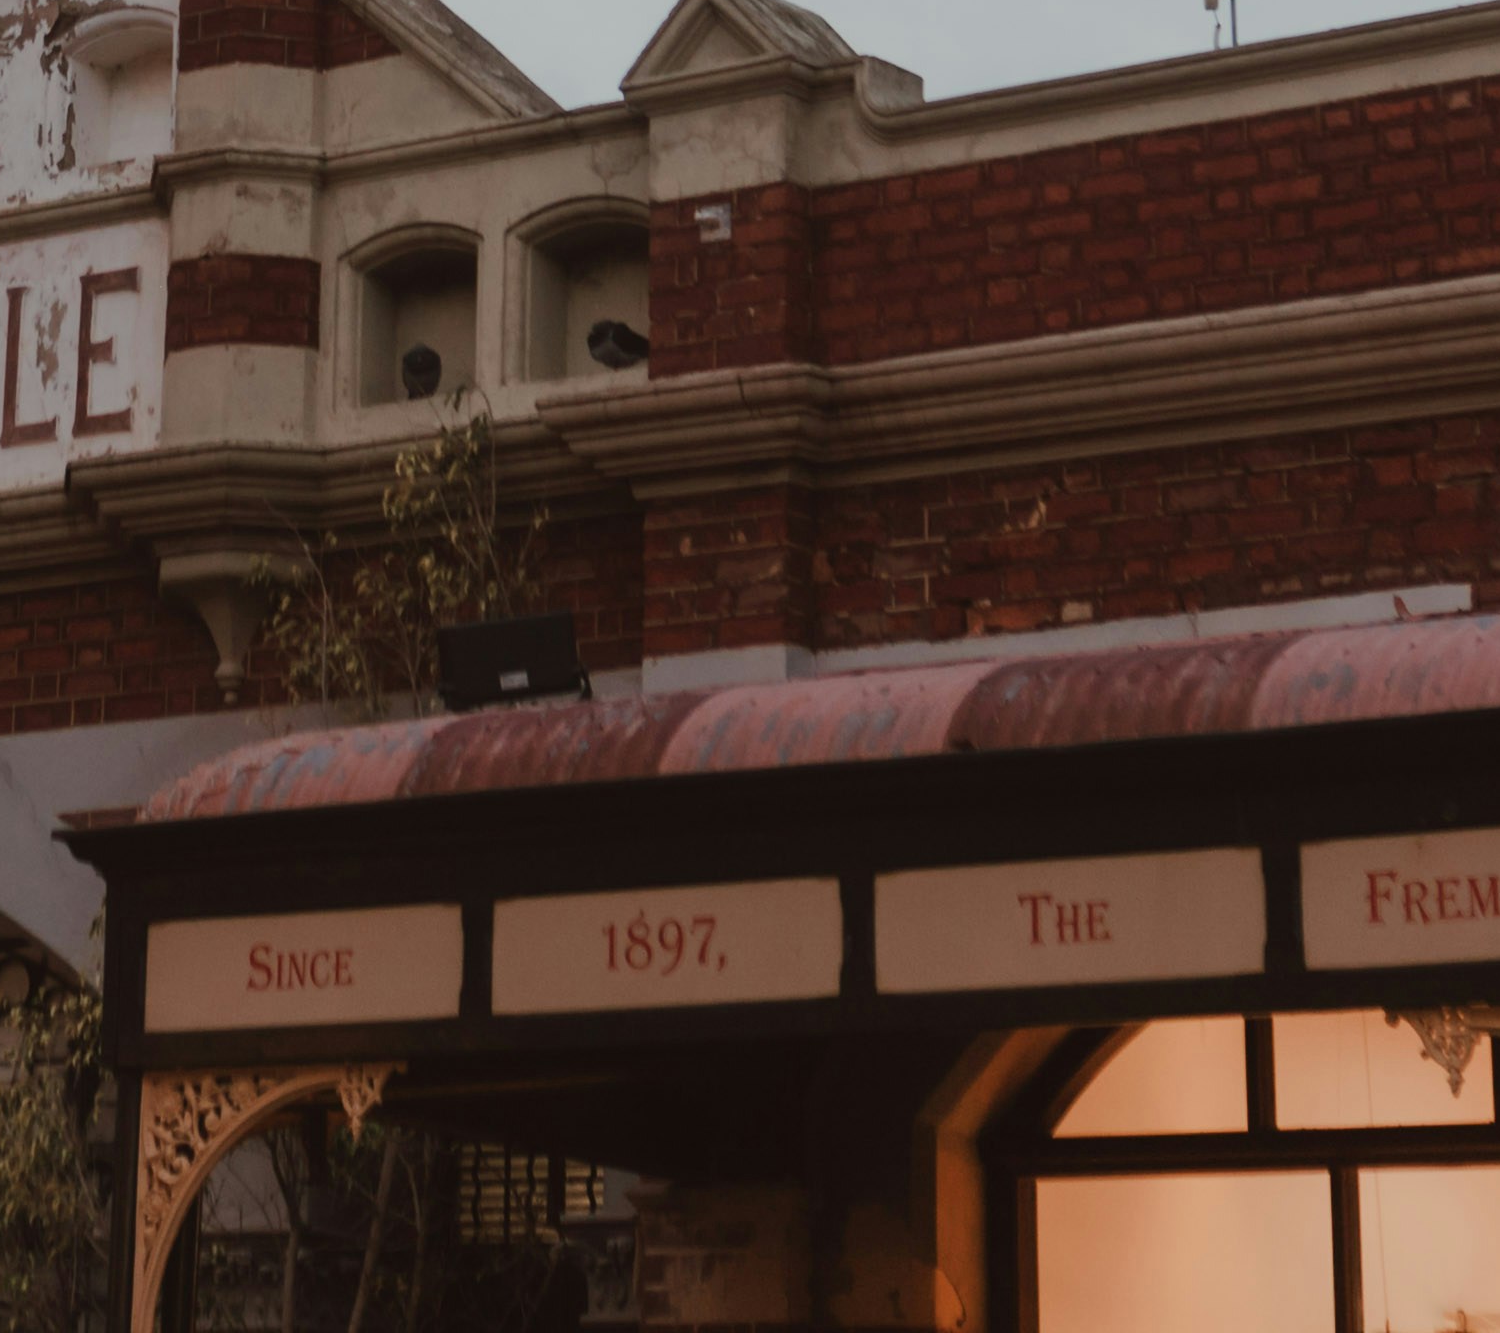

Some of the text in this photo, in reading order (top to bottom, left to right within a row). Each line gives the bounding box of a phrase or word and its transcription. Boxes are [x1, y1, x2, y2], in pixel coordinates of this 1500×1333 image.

[601, 910, 729, 977] 1897,
[1018, 891, 1113, 946] THE
[246, 941, 355, 993] SINCE
